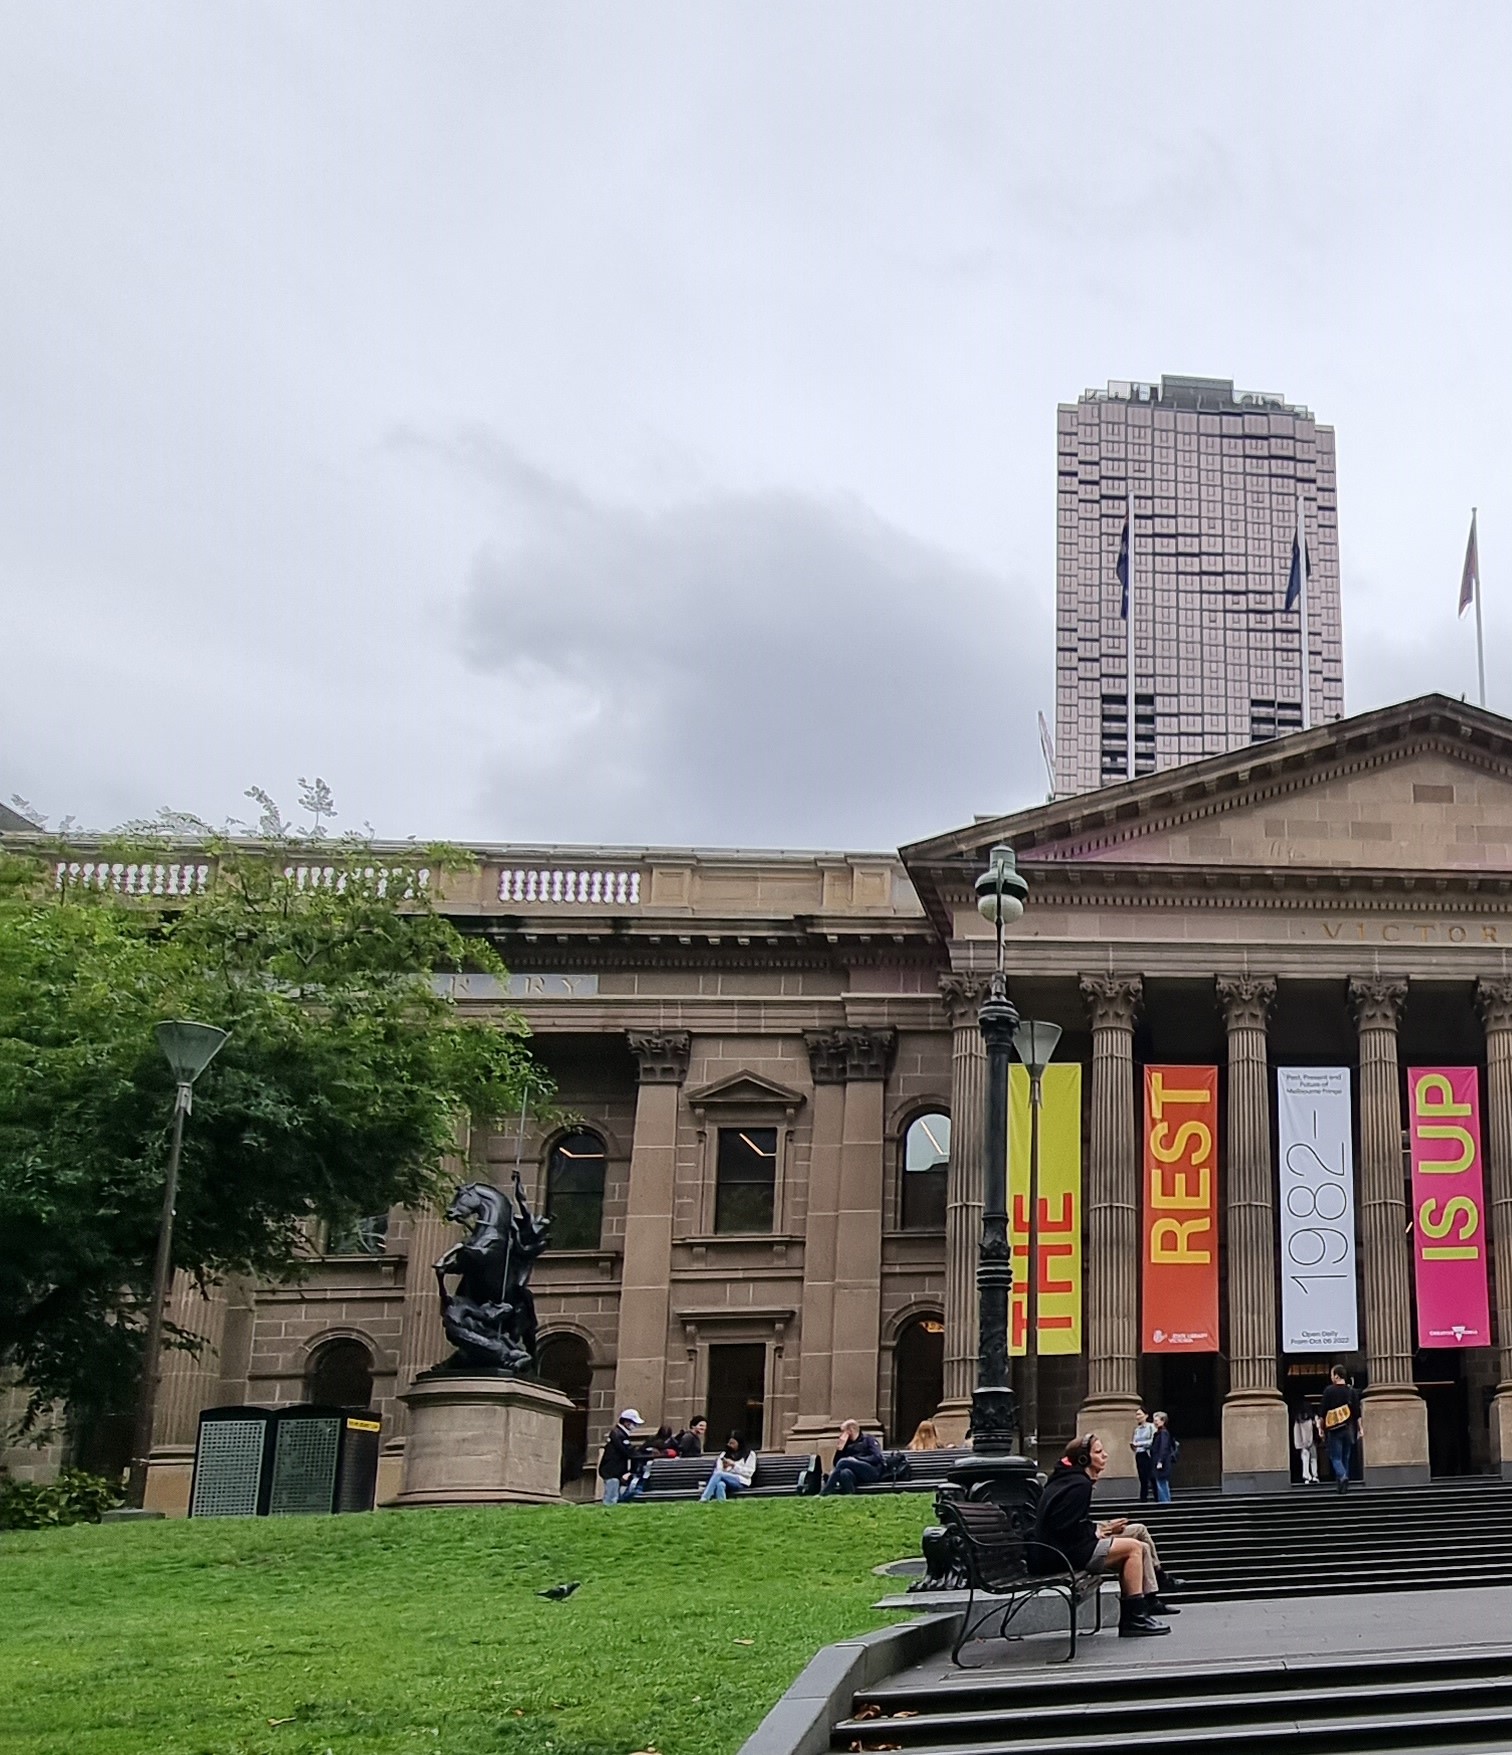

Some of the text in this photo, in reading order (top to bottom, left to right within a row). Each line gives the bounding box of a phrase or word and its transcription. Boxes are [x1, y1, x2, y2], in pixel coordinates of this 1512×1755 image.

[1150, 1072, 1212, 1264] REST
[1414, 1073, 1479, 1261] IS UP
[1012, 1192, 1073, 1347] THE
